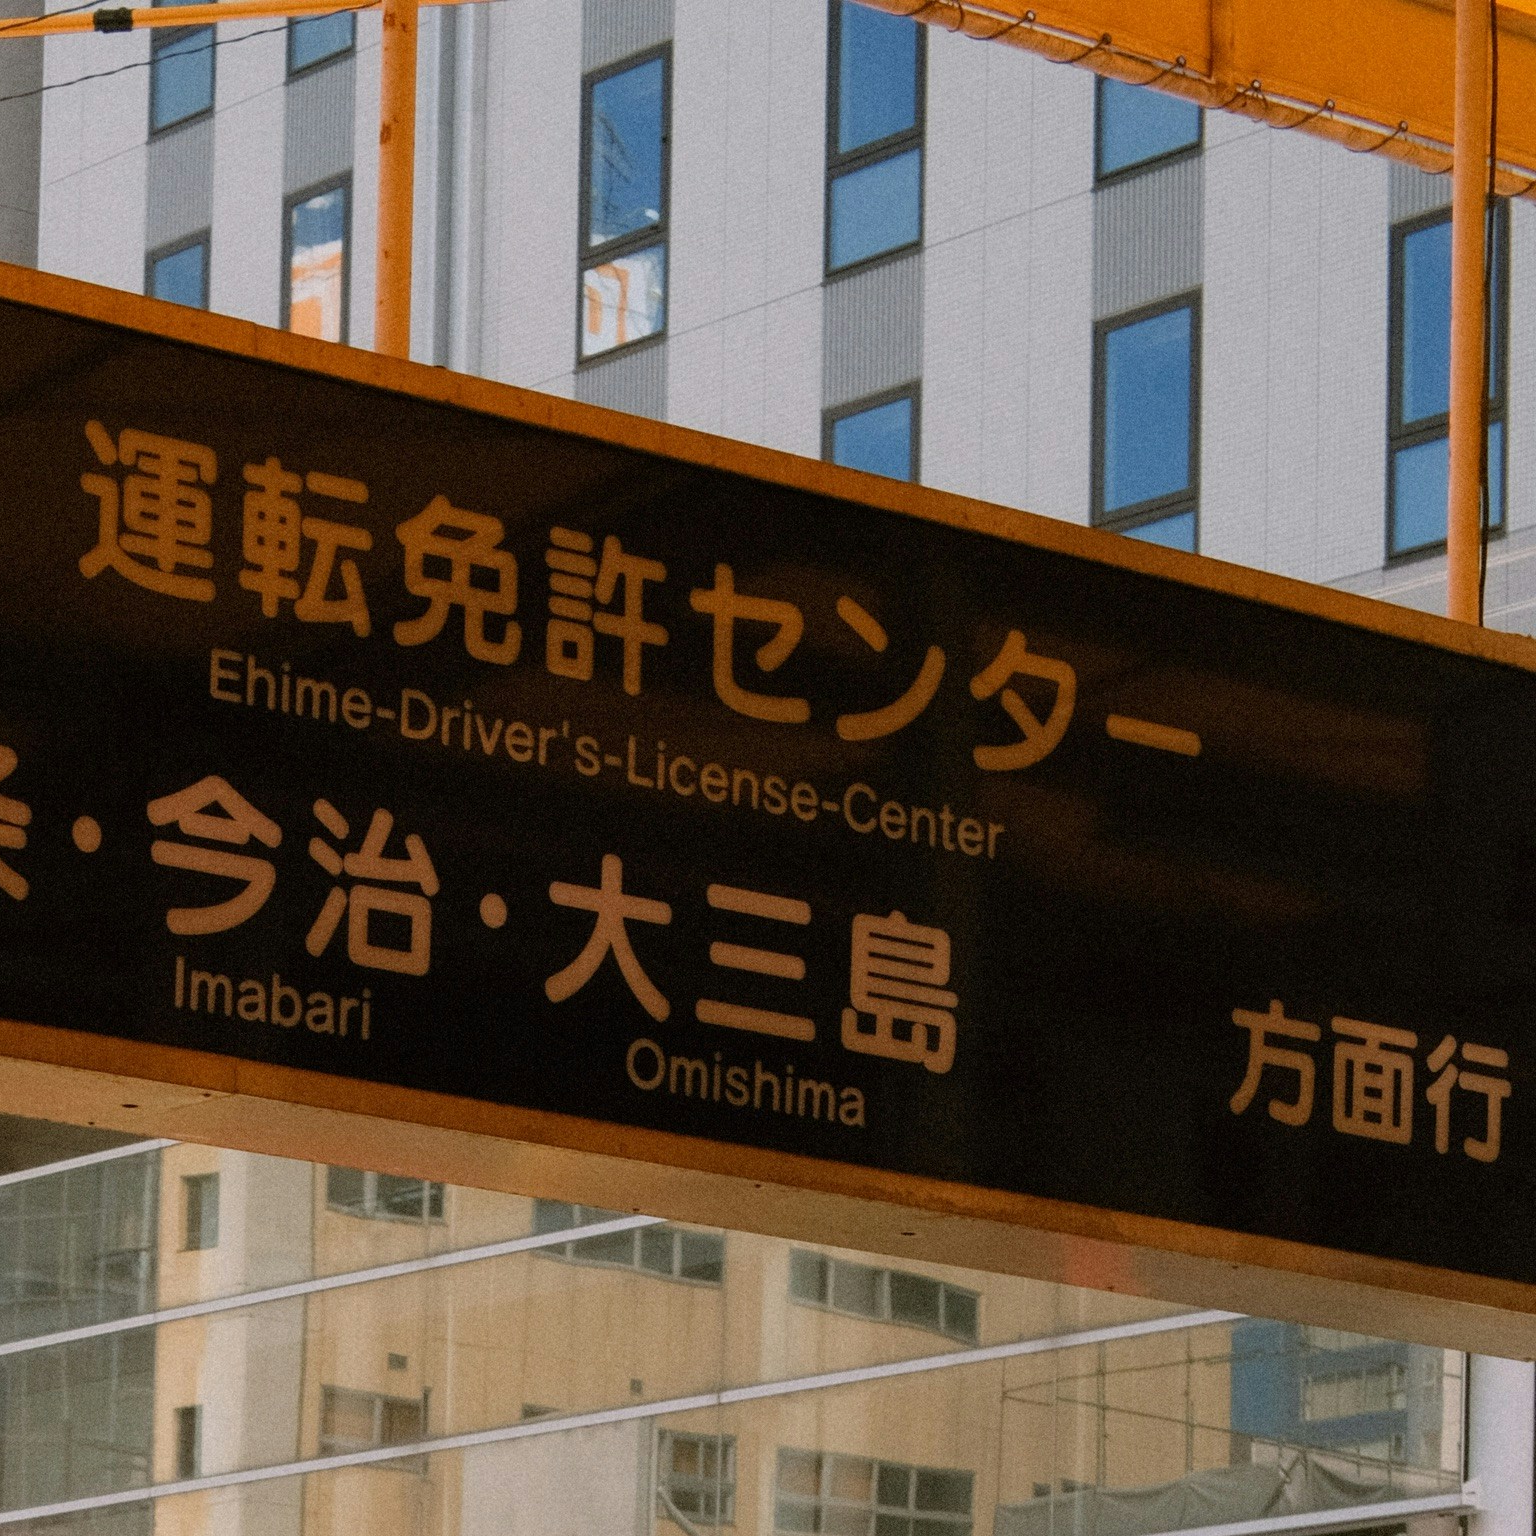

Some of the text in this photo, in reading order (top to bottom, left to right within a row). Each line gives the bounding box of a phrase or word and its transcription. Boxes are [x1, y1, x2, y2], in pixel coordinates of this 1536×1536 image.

[78, 419, 1204, 773] 運転免許センター
[173, 956, 372, 1041] Imabari
[626, 1038, 866, 1128] Omishima
[1230, 1001, 1512, 1163] 方面行
